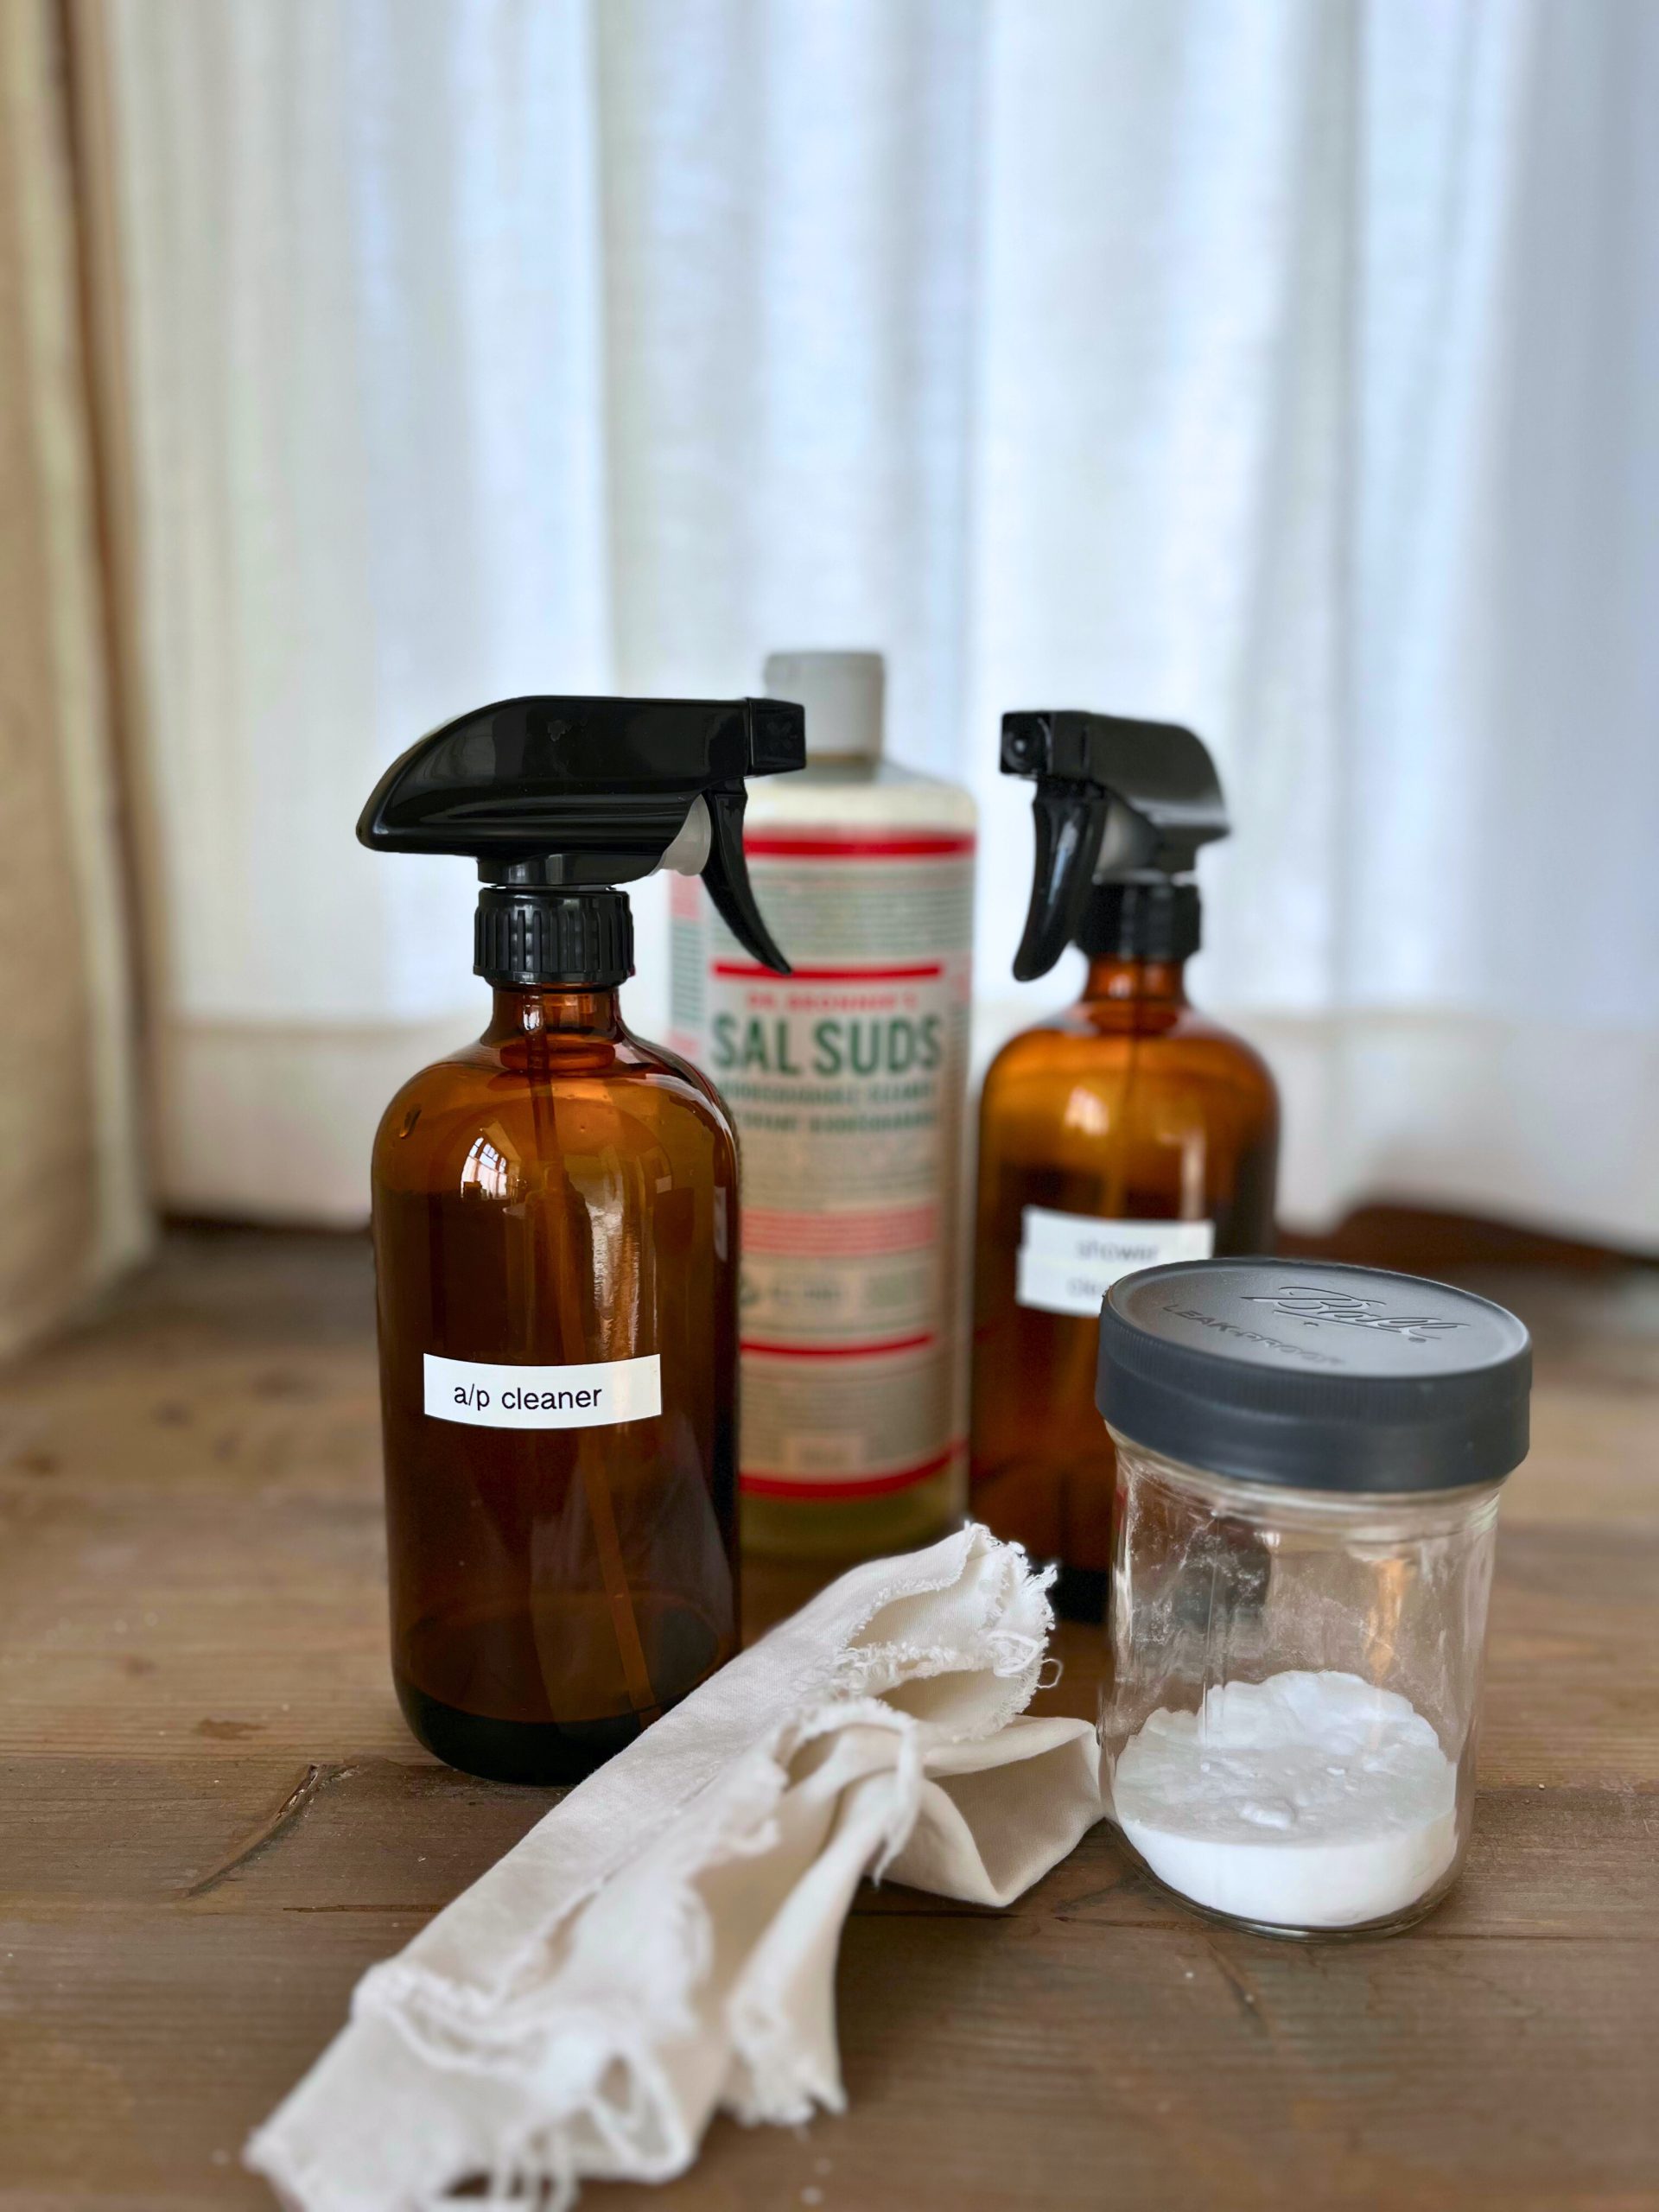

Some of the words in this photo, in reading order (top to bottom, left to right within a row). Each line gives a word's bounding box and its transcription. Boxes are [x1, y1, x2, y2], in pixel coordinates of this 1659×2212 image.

[714, 1014, 800, 1075] SAL
[813, 1014, 942, 1076] SUDS
[454, 1383, 490, 1411] a/p
[501, 1387, 602, 1410] cleaner
